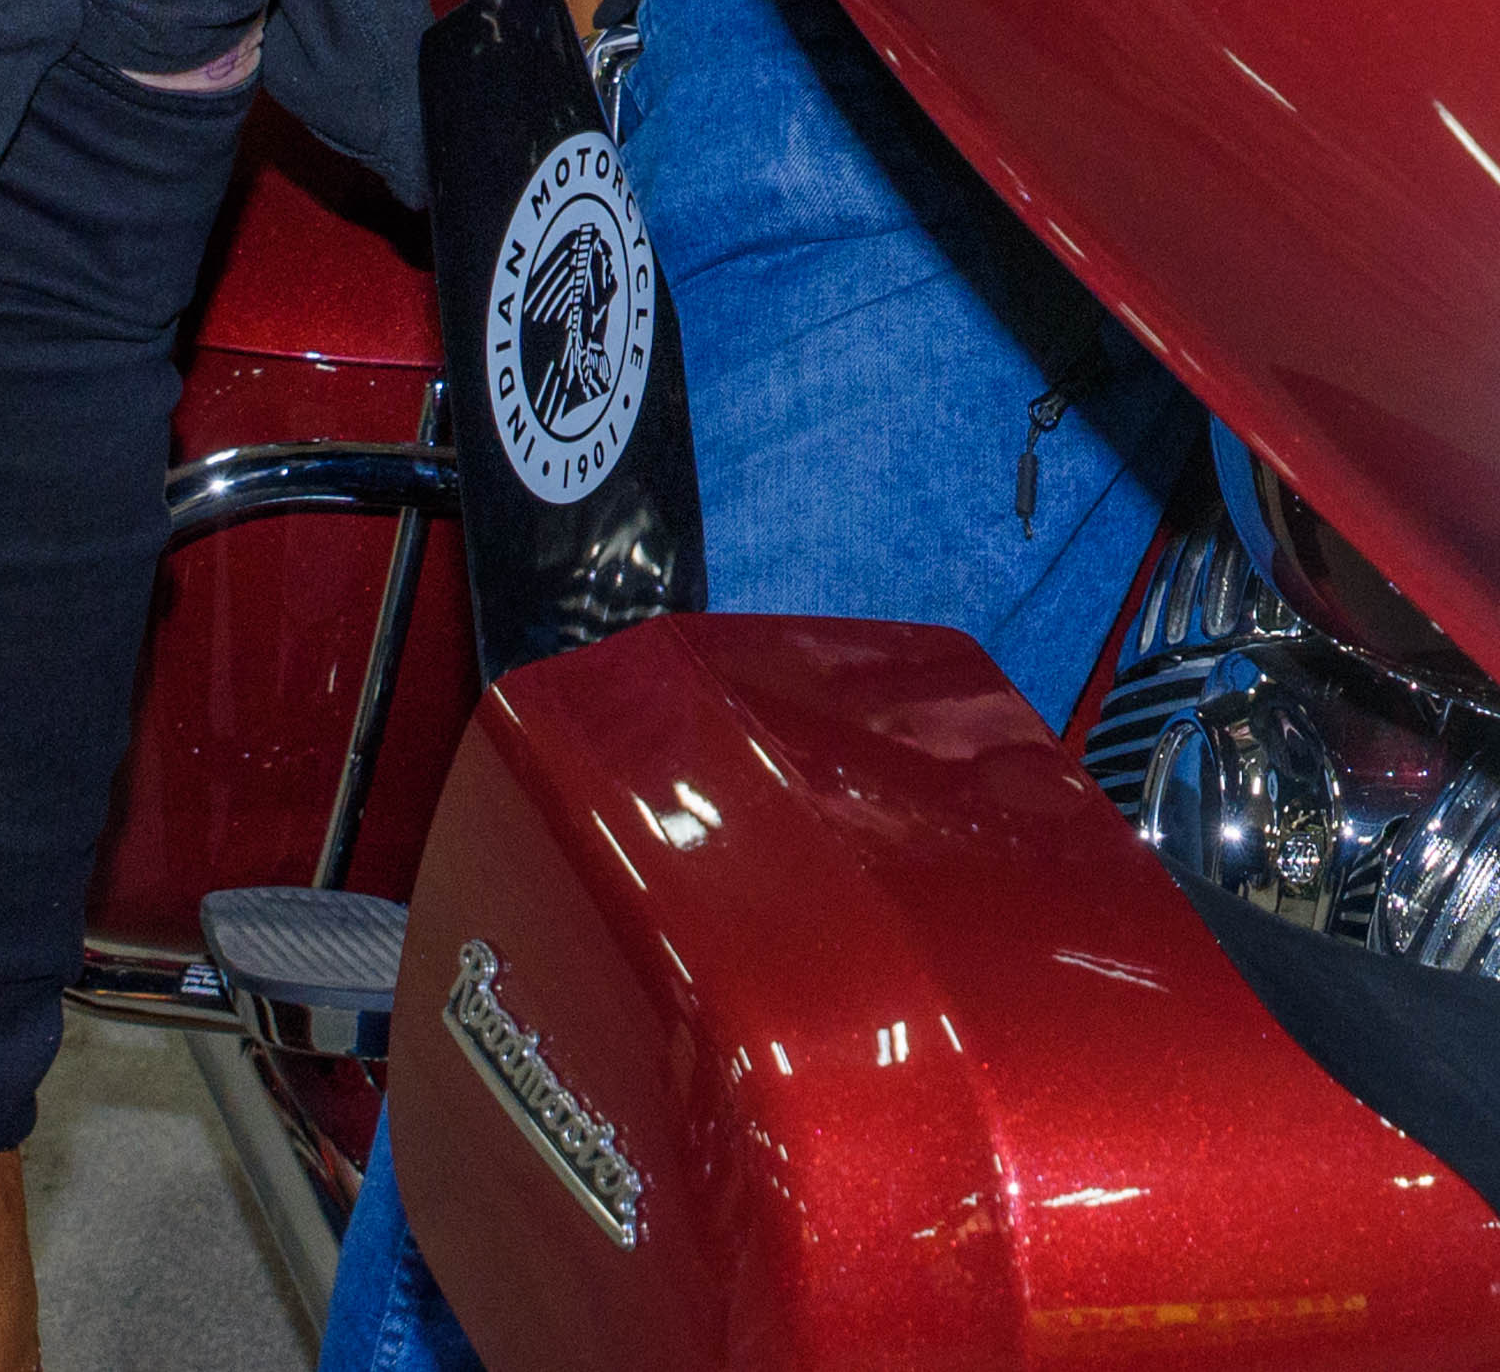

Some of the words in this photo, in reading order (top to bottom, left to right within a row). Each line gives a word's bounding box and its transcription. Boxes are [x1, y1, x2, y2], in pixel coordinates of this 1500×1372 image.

[494, 238, 537, 464] INDIAN
[530, 146, 650, 372] MOTORCYCLE
[562, 421, 619, 489] 1901
[446, 939, 643, 1240] Roadmaster
